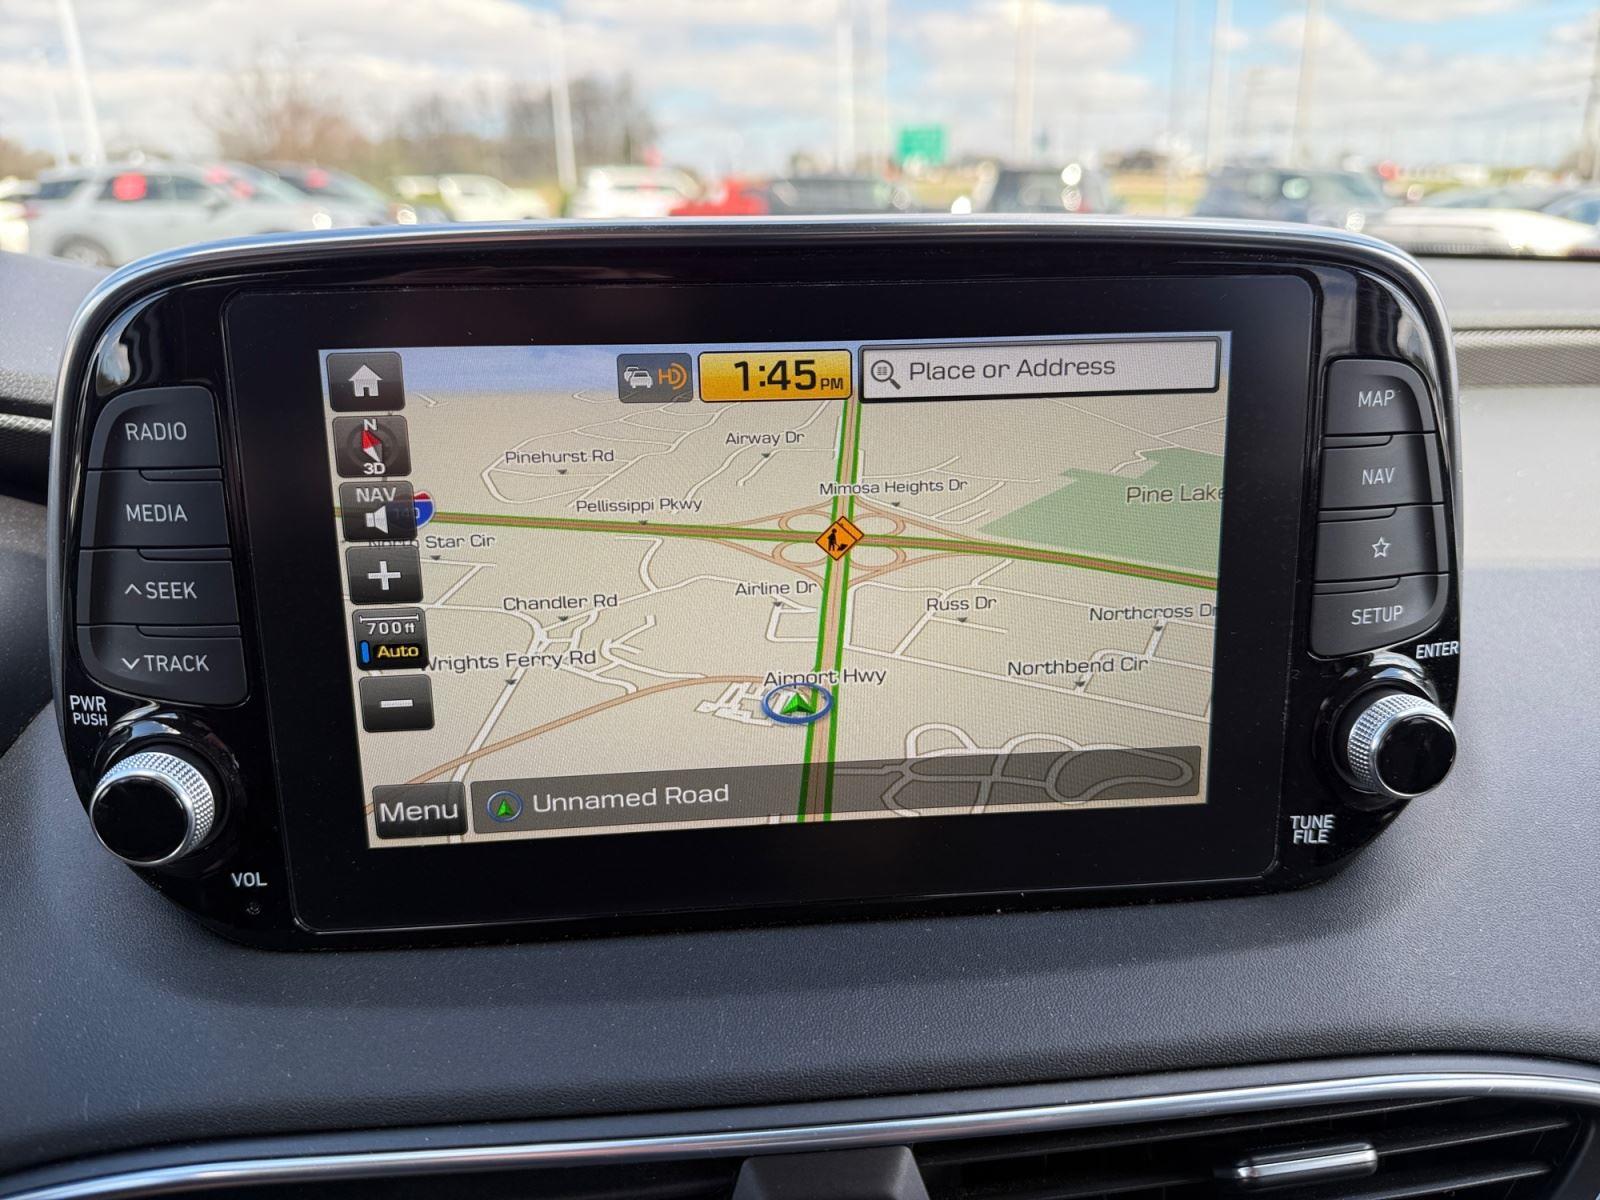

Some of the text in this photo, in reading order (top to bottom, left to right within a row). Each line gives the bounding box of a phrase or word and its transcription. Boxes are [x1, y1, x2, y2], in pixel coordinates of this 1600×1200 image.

[734, 360, 844, 391] 1:45 PM
[909, 358, 1116, 381] Place or Address
[1358, 390, 1395, 408] MAP
[125, 422, 188, 441] RADIO
[363, 418, 378, 431] N
[725, 431, 805, 448] Airway Dr
[505, 449, 614, 465] Pinehurst Rd
[363, 462, 386, 475] 3D
[1362, 468, 1395, 486] NAV
[356, 487, 397, 503] NAV
[819, 479, 968, 497] Mimosa Heights Dr
[1126, 485, 1174, 504] Pine
[125, 504, 189, 523] MEDIA
[576, 497, 702, 514] Pellissippi Pkwy
[425, 535, 465, 549] Star
[469, 534, 496, 548] Cir
[145, 581, 198, 600] SEEK
[735, 580, 817, 596] Airline Dr
[503, 593, 618, 612] Chandler Rd
[926, 595, 997, 612] Russ Dr
[1089, 606, 1194, 622] Northcross
[1351, 606, 1403, 625] SETUP
[367, 621, 416, 635] 700 ft
[377, 644, 419, 658] Auto
[1415, 640, 1459, 659] ENTER
[144, 655, 210, 672] TRACK
[506, 653, 562, 671] Ferry
[568, 649, 597, 667] Rd
[1007, 657, 1149, 677] Northbend Cir
[763, 668, 887, 689] Airport Hwy
[69, 695, 107, 712] PWR
[72, 712, 108, 726] PUSH
[533, 784, 729, 812] Unnamed Road
[379, 800, 459, 824] Menu
[1290, 814, 1335, 831] TUNE
[1292, 829, 1329, 845] FILE
[231, 871, 267, 888] VOL
